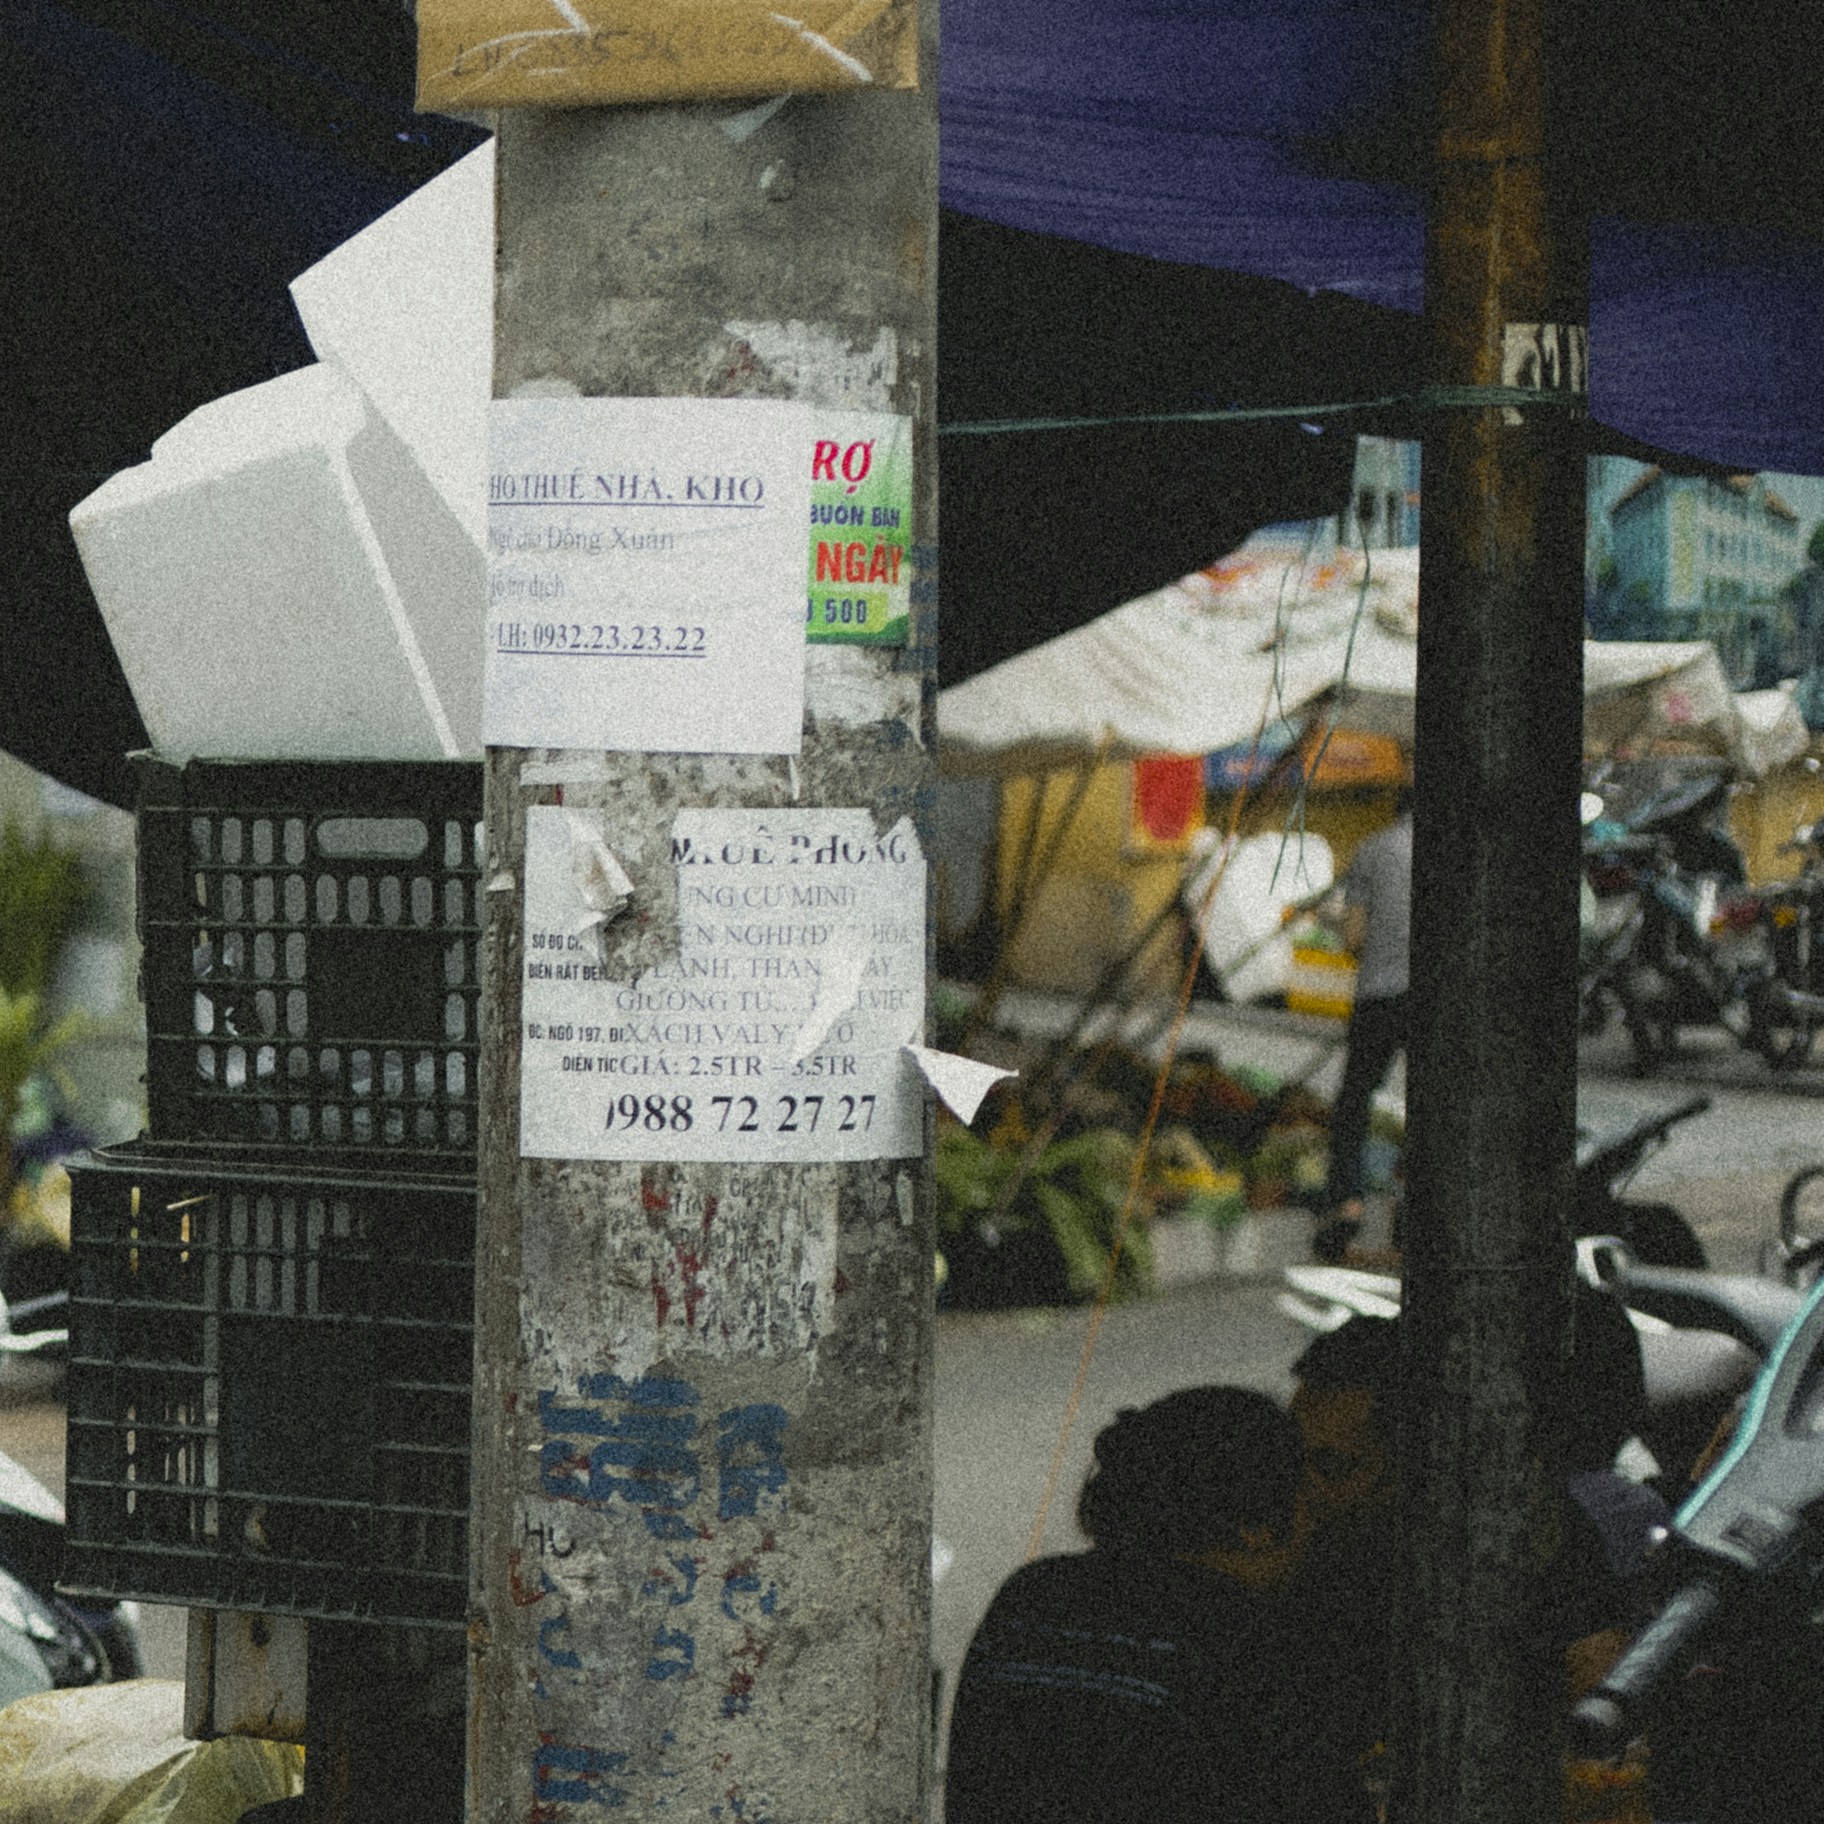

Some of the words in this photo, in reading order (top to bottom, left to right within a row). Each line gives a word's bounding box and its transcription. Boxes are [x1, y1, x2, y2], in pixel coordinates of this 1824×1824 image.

[685, 475, 765, 502] KHO
[815, 533, 905, 586] NGÀY
[532, 624, 707, 653] 0932.23.23.22
[749, 956, 823, 980] THAN
[689, 1055, 762, 1078] 2.5TR
[712, 1094, 760, 1132] 72
[777, 1094, 825, 1132] 27
[838, 1093, 877, 1132] 27
